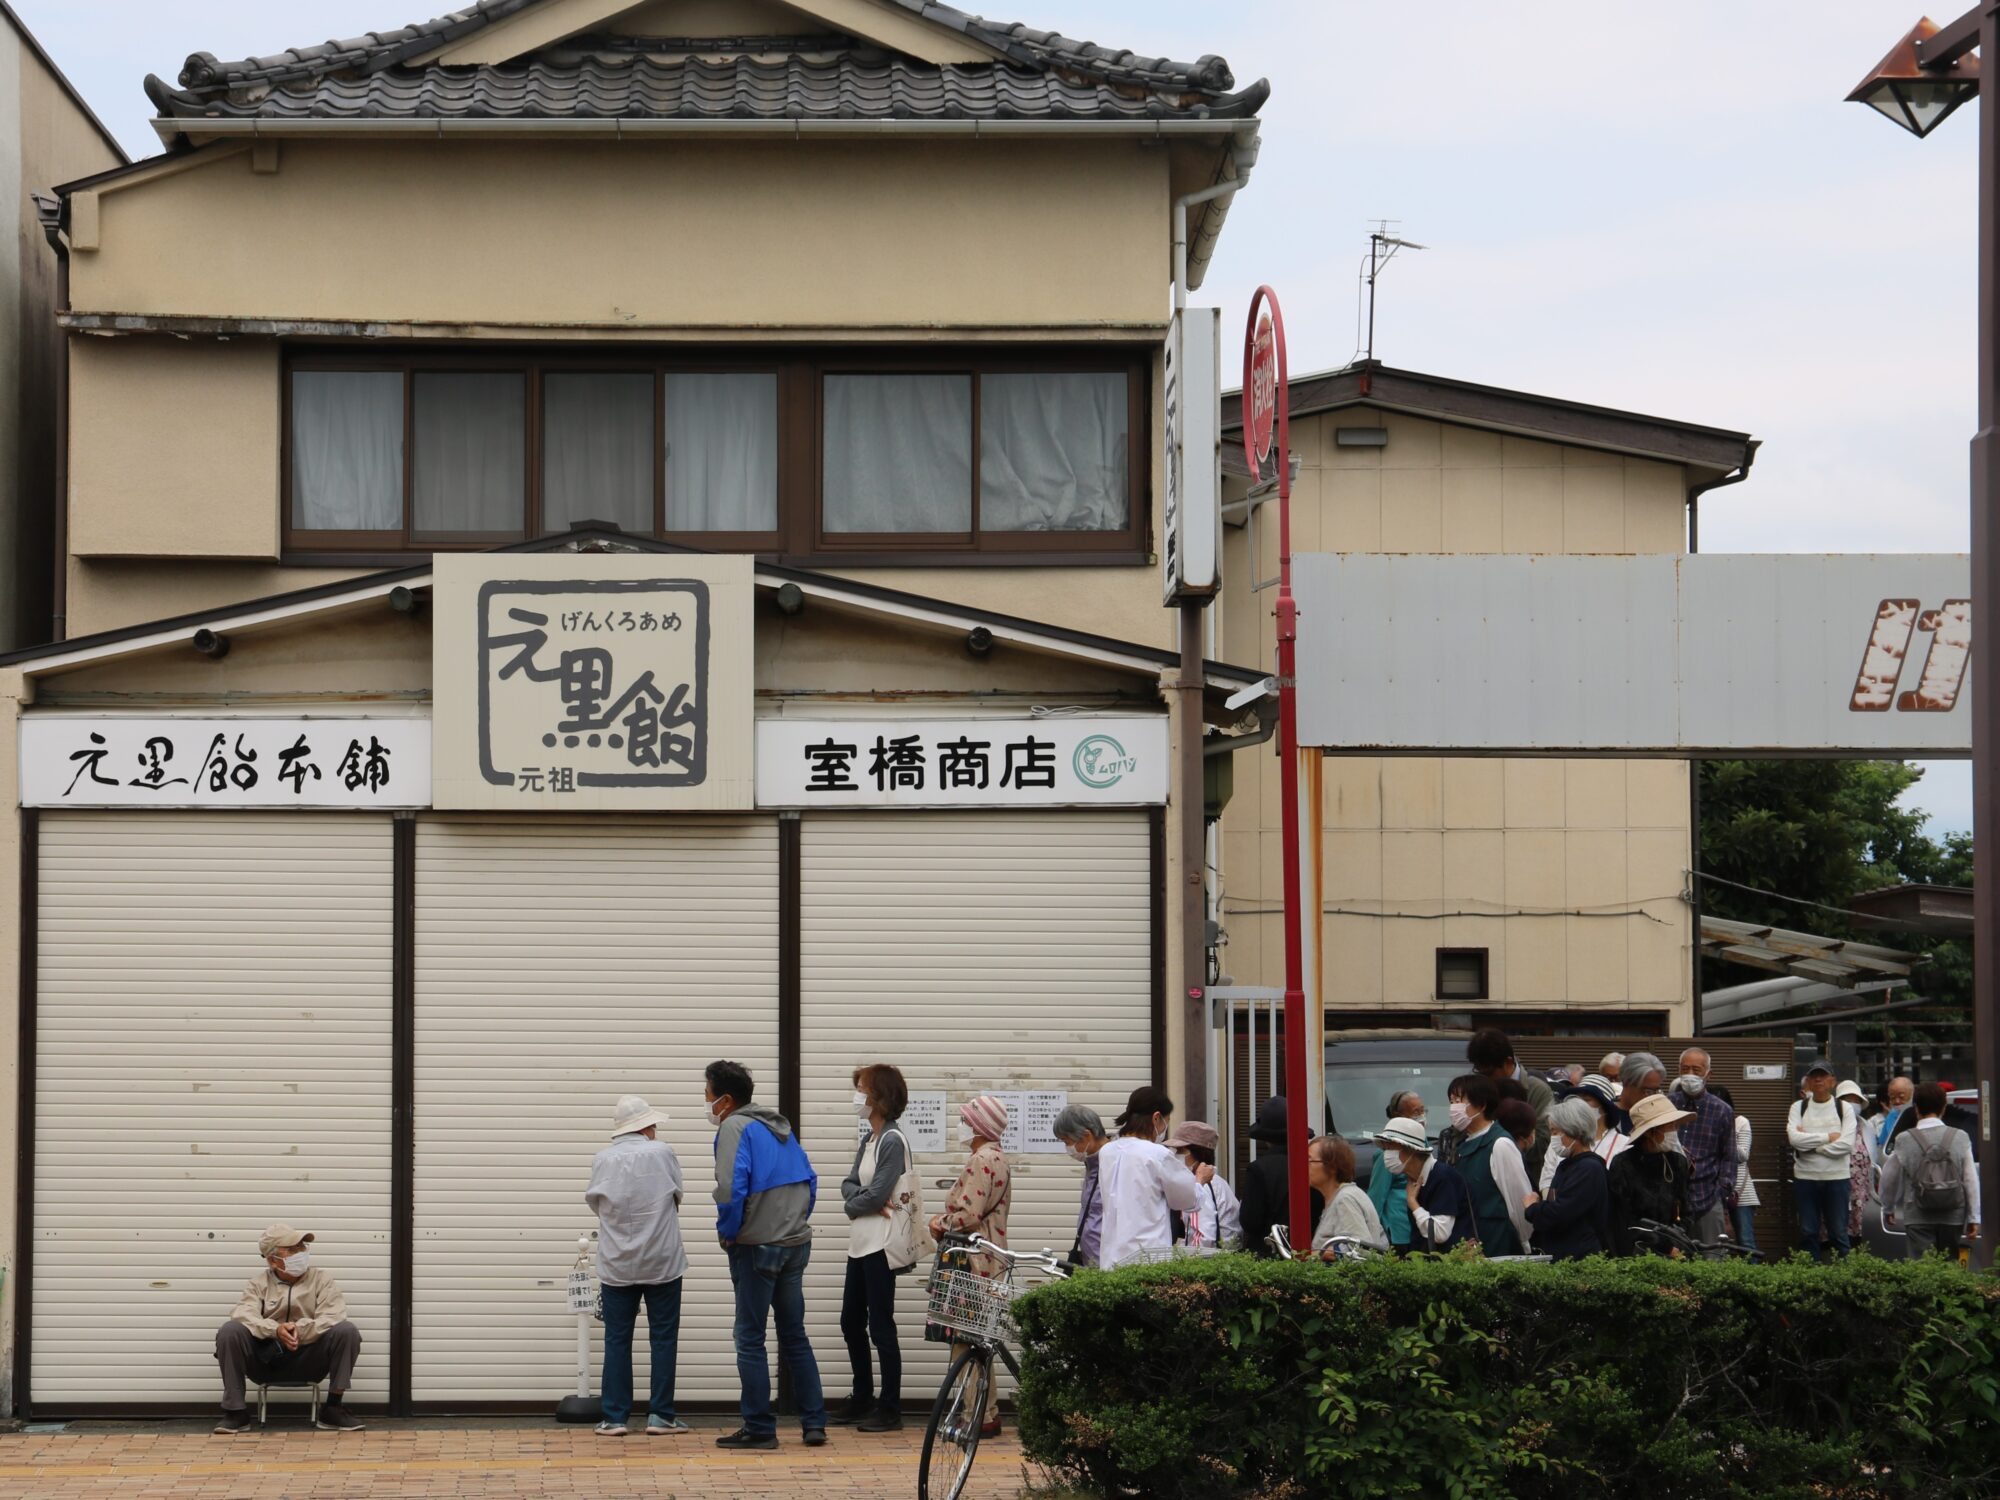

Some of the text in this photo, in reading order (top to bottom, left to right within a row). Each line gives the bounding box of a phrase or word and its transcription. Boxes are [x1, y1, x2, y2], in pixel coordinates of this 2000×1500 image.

[560, 610, 683, 633] げんくろあめ
[62, 731, 392, 797] 元黒飴本舗
[517, 766, 577, 793] 元祖
[804, 733, 1057, 793] 室橋商店
